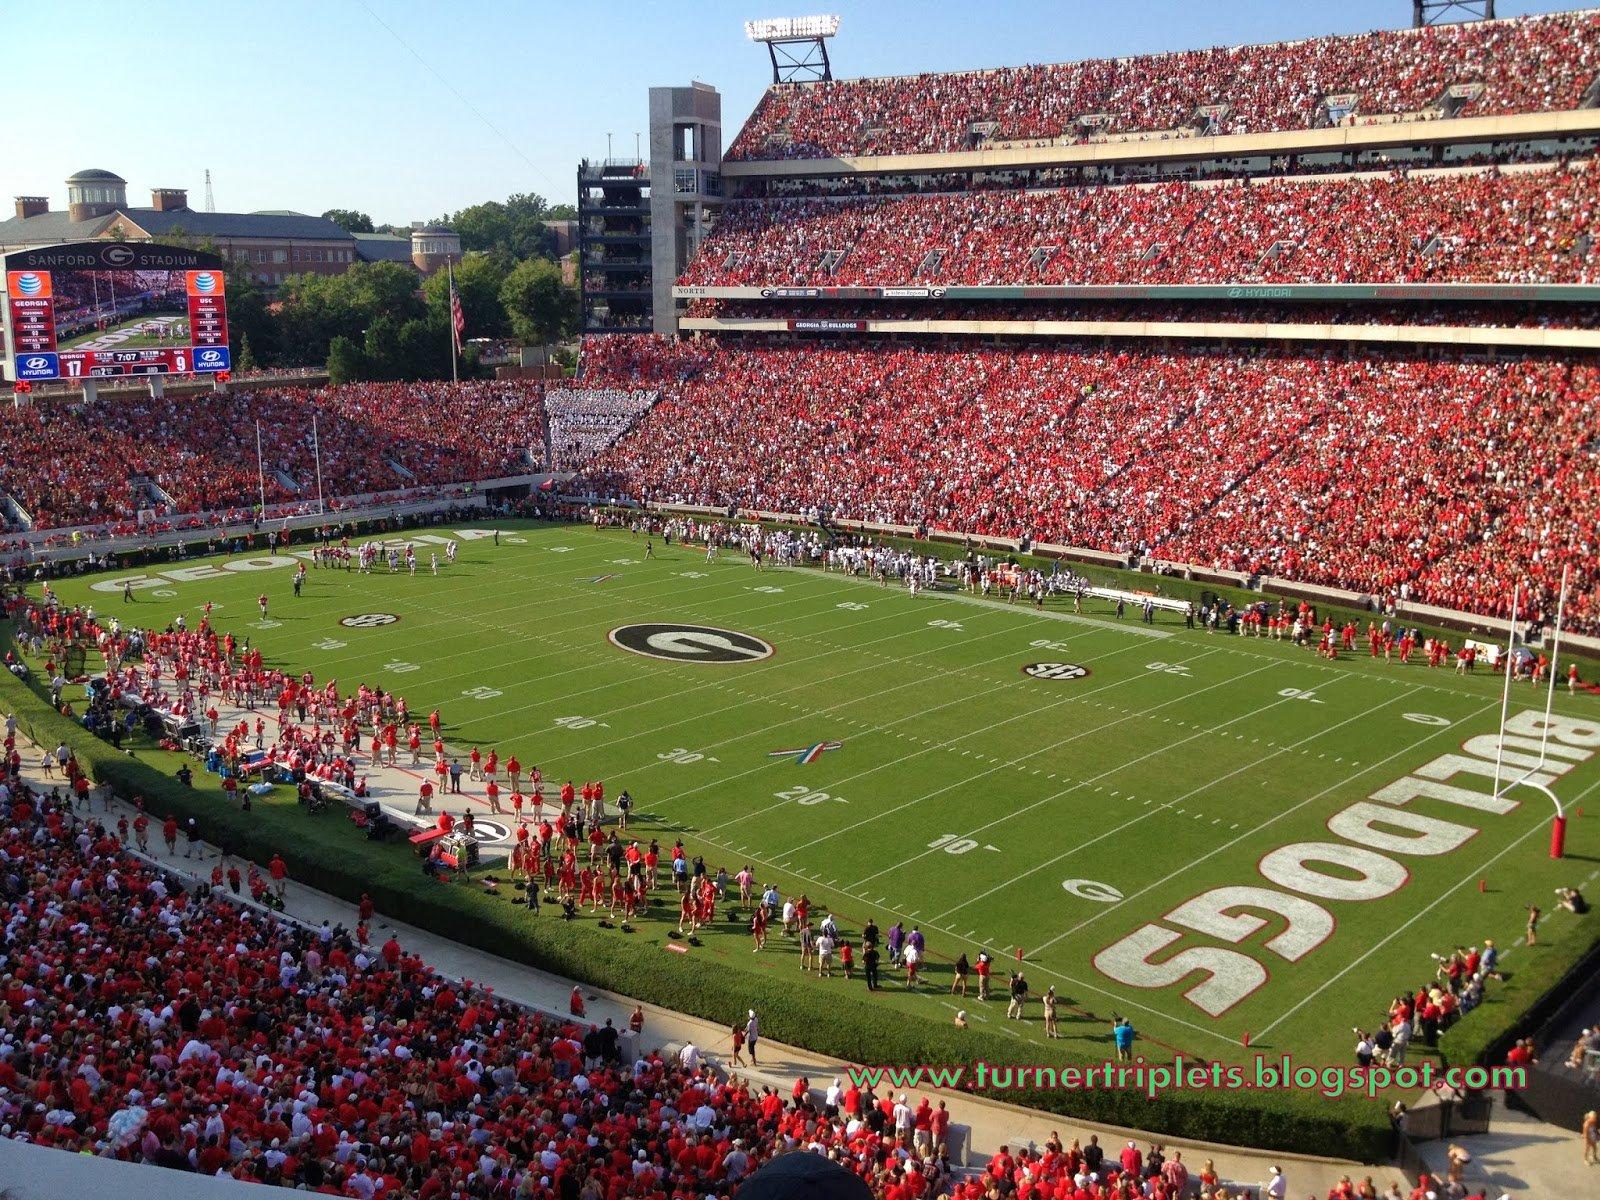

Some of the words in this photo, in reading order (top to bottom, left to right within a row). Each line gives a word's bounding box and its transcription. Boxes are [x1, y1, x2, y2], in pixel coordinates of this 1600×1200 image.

[28, 255, 96, 266] SANFORD
[141, 255, 198, 265] STADIUM
[1245, 288, 1292, 298] HYUNDAI
[796, 321, 820, 329] GEORGIA
[117, 353, 136, 362] 7:07
[176, 356, 186, 372] 9
[23, 368, 53, 376] HYUNDAI
[66, 361, 81, 376] 17
[217, 371, 230, 381] 25
[15, 381, 31, 392] 25
[927, 619, 964, 630] 40
[1029, 639, 1068, 651] 30
[1026, 662, 1086, 680] SEC
[1145, 661, 1190, 675] 20
[461, 685, 503, 700] 50
[1277, 688, 1316, 700] 10
[553, 715, 597, 730] 40
[657, 747, 704, 764] 30
[773, 785, 830, 806] 20
[927, 833, 979, 855] 10
[1092, 709, 1600, 1018] BULLDOGS
[1061, 878, 1124, 903] G
